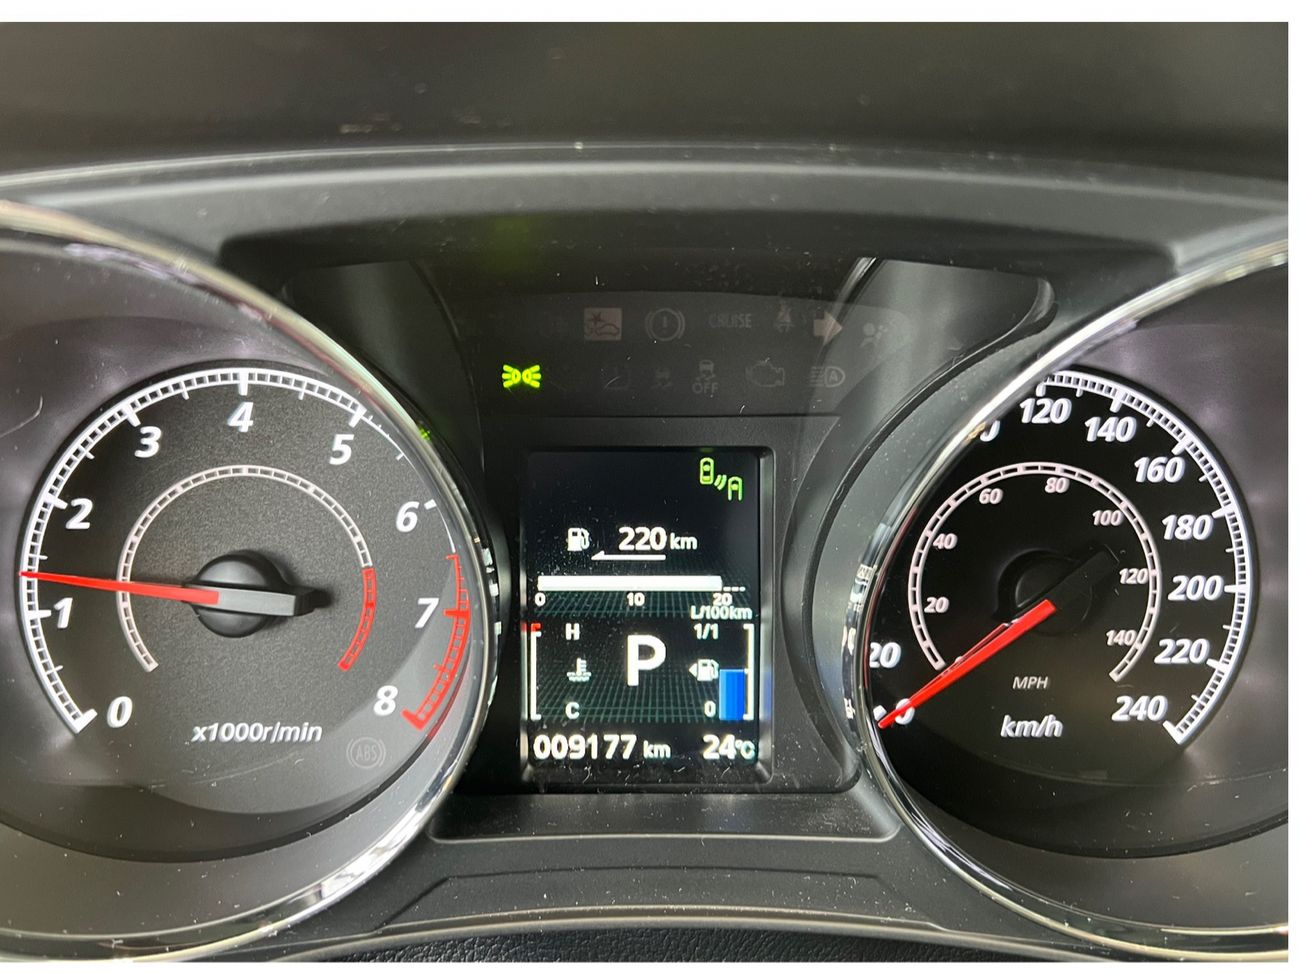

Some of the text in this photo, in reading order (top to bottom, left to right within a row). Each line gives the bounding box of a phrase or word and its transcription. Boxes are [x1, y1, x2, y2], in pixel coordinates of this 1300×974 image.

[692, 382, 719, 394] OFF
[228, 402, 254, 432] 4
[1019, 398, 1072, 426] 120
[1084, 416, 1137, 444] 140
[135, 427, 161, 459] 3
[330, 433, 353, 464] 5
[1134, 456, 1185, 483] 160
[979, 488, 1003, 505] 60
[1044, 477, 1069, 494] 80
[67, 498, 91, 530] 2
[396, 501, 418, 532] 6
[1092, 510, 1124, 527] 100
[618, 527, 697, 550] 220 km
[1162, 514, 1213, 541] 180
[932, 534, 958, 551] 40
[1119, 568, 1149, 585] 120
[1167, 575, 1223, 602] 200
[534, 593, 732, 606] 0 10 20
[924, 596, 949, 614] 20
[53, 599, 72, 628] 1
[415, 598, 440, 627] 7
[690, 606, 752, 620] L/100km
[565, 624, 580, 640] H
[694, 624, 718, 640] 1/1
[1106, 630, 1136, 647] 140
[627, 635, 667, 686] P
[1154, 639, 1210, 665] 220
[1013, 675, 1049, 690] MPH
[107, 697, 133, 727] 0
[374, 685, 398, 715] 8
[565, 703, 580, 719] C
[704, 702, 716, 717] 0
[1112, 695, 1168, 722] 240
[191, 720, 322, 744] x1000r/min
[1000, 714, 1063, 738] km/h
[533, 735, 671, 759] 009177 km
